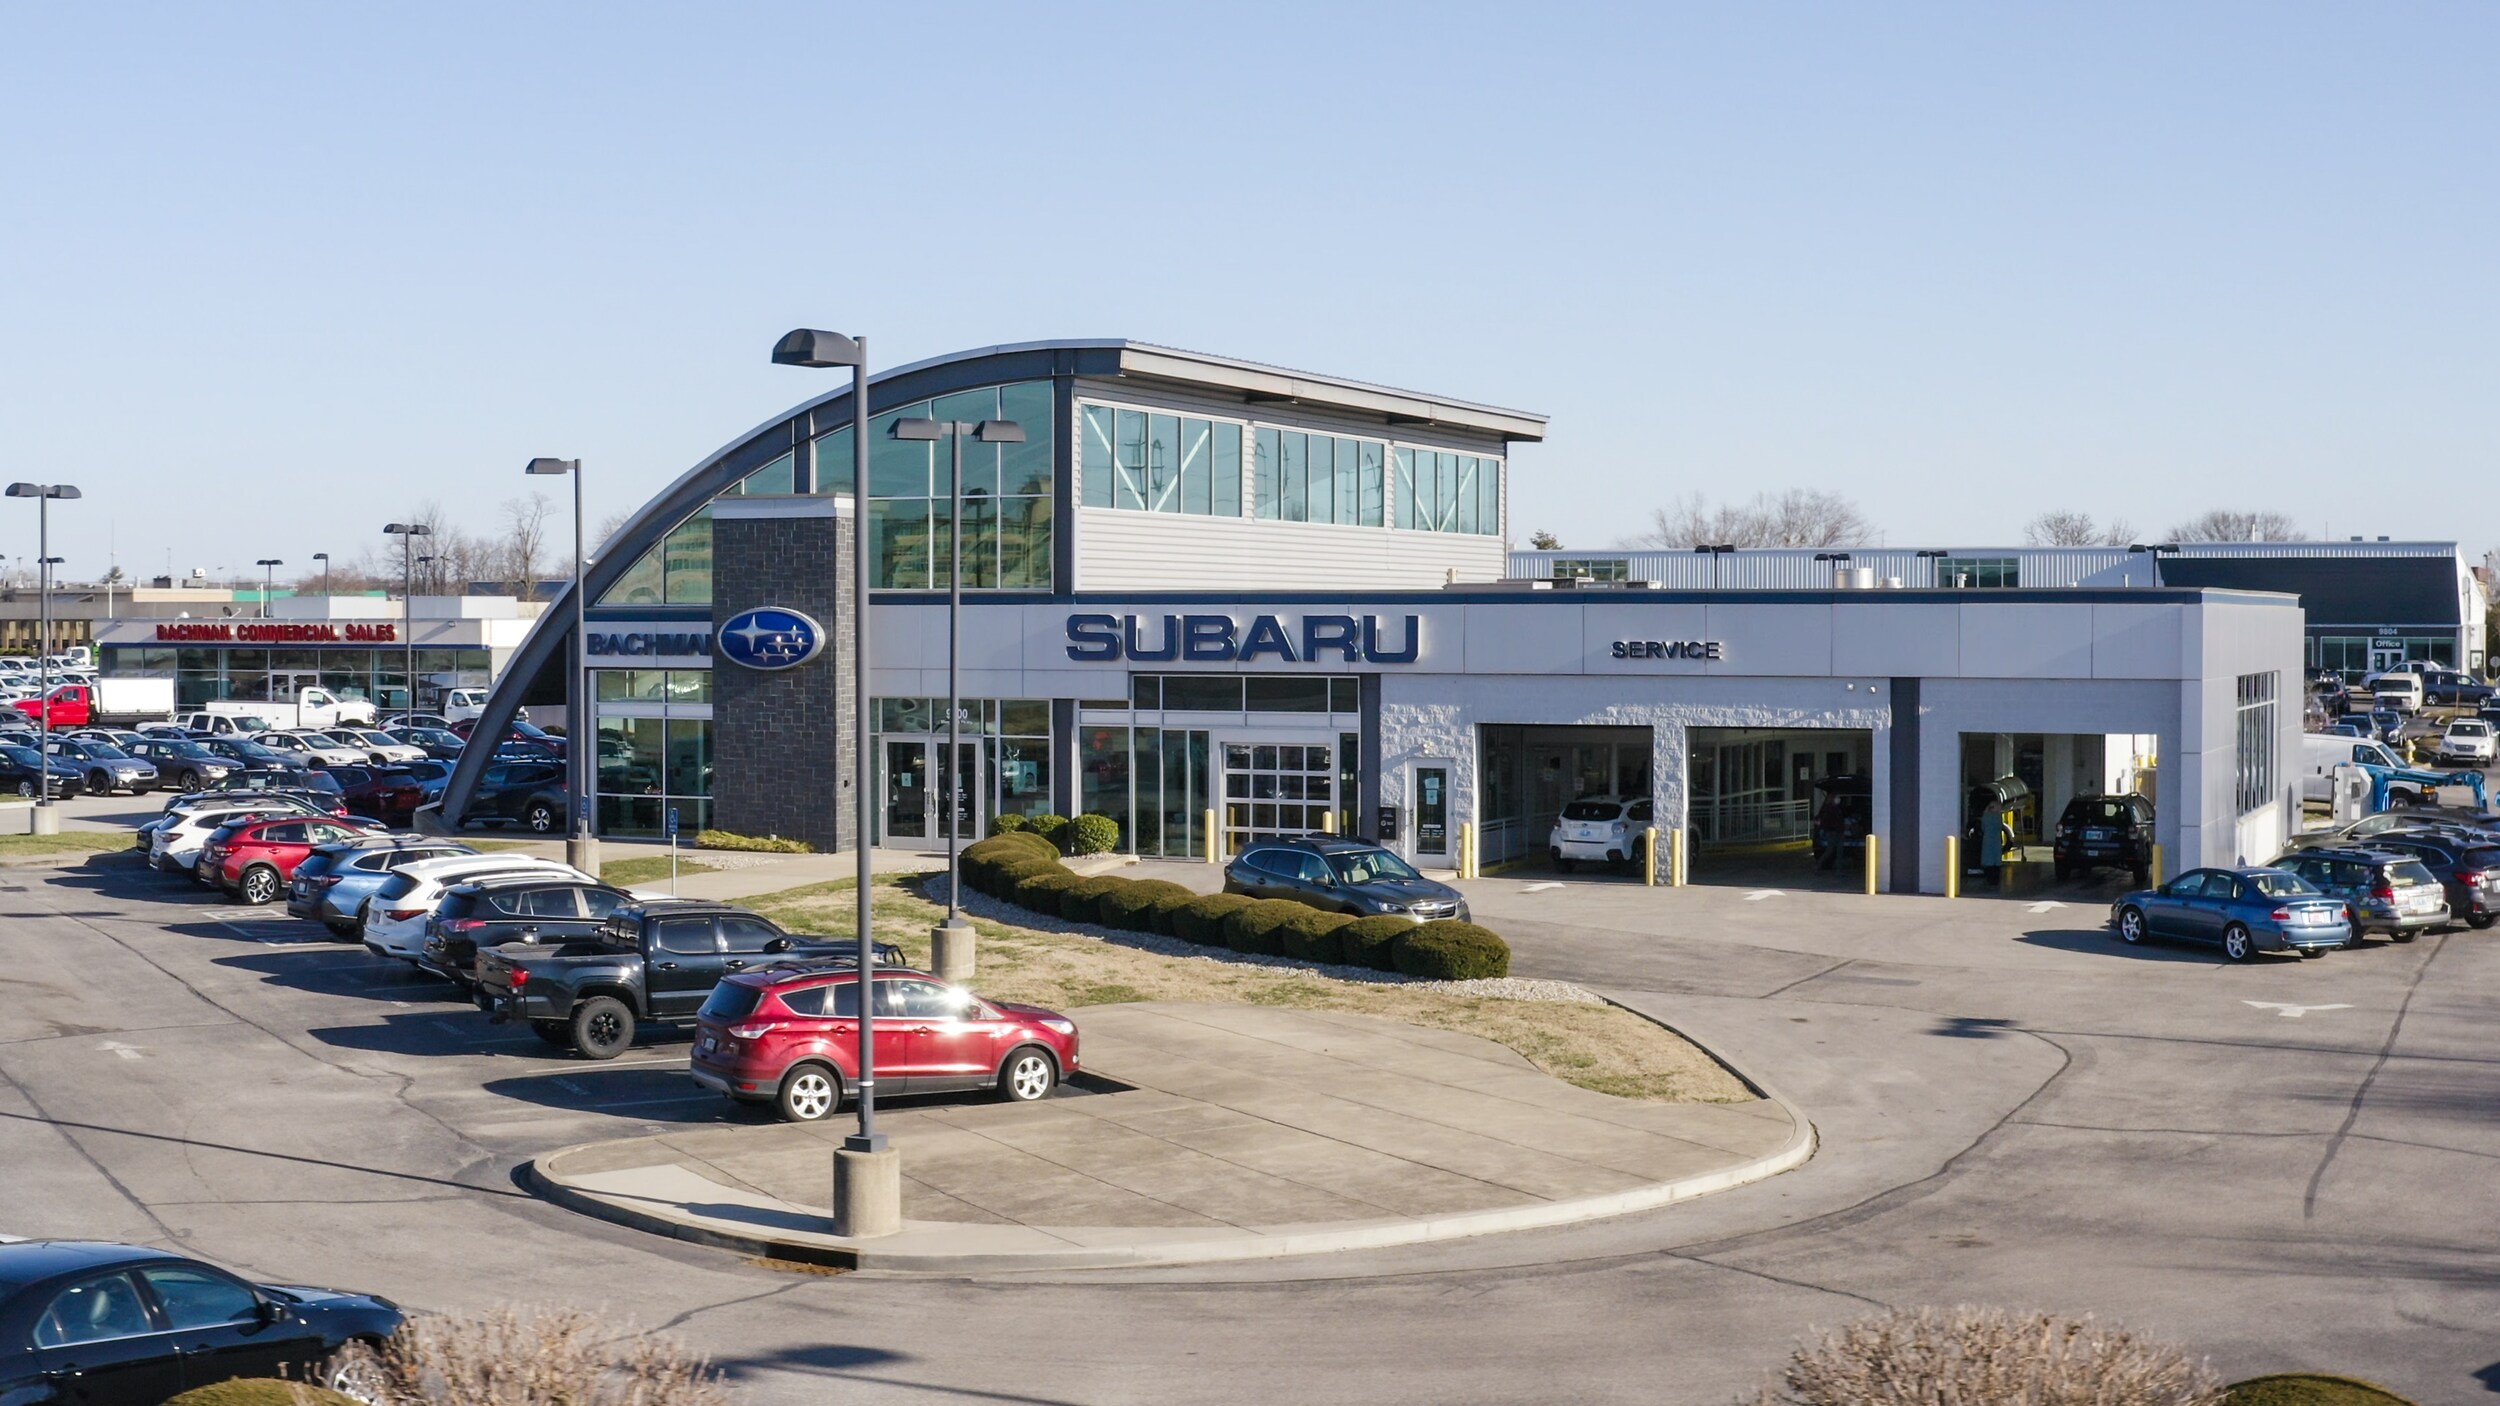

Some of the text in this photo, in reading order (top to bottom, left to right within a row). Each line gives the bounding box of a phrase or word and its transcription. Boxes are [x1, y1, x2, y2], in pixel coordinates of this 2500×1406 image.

[156, 624, 396, 642] BACHMAN COMMERCIAL SALES
[1065, 614, 1421, 663] SUBARU
[1610, 640, 1721, 660] SERVICE
[2375, 639, 2401, 648] Office
